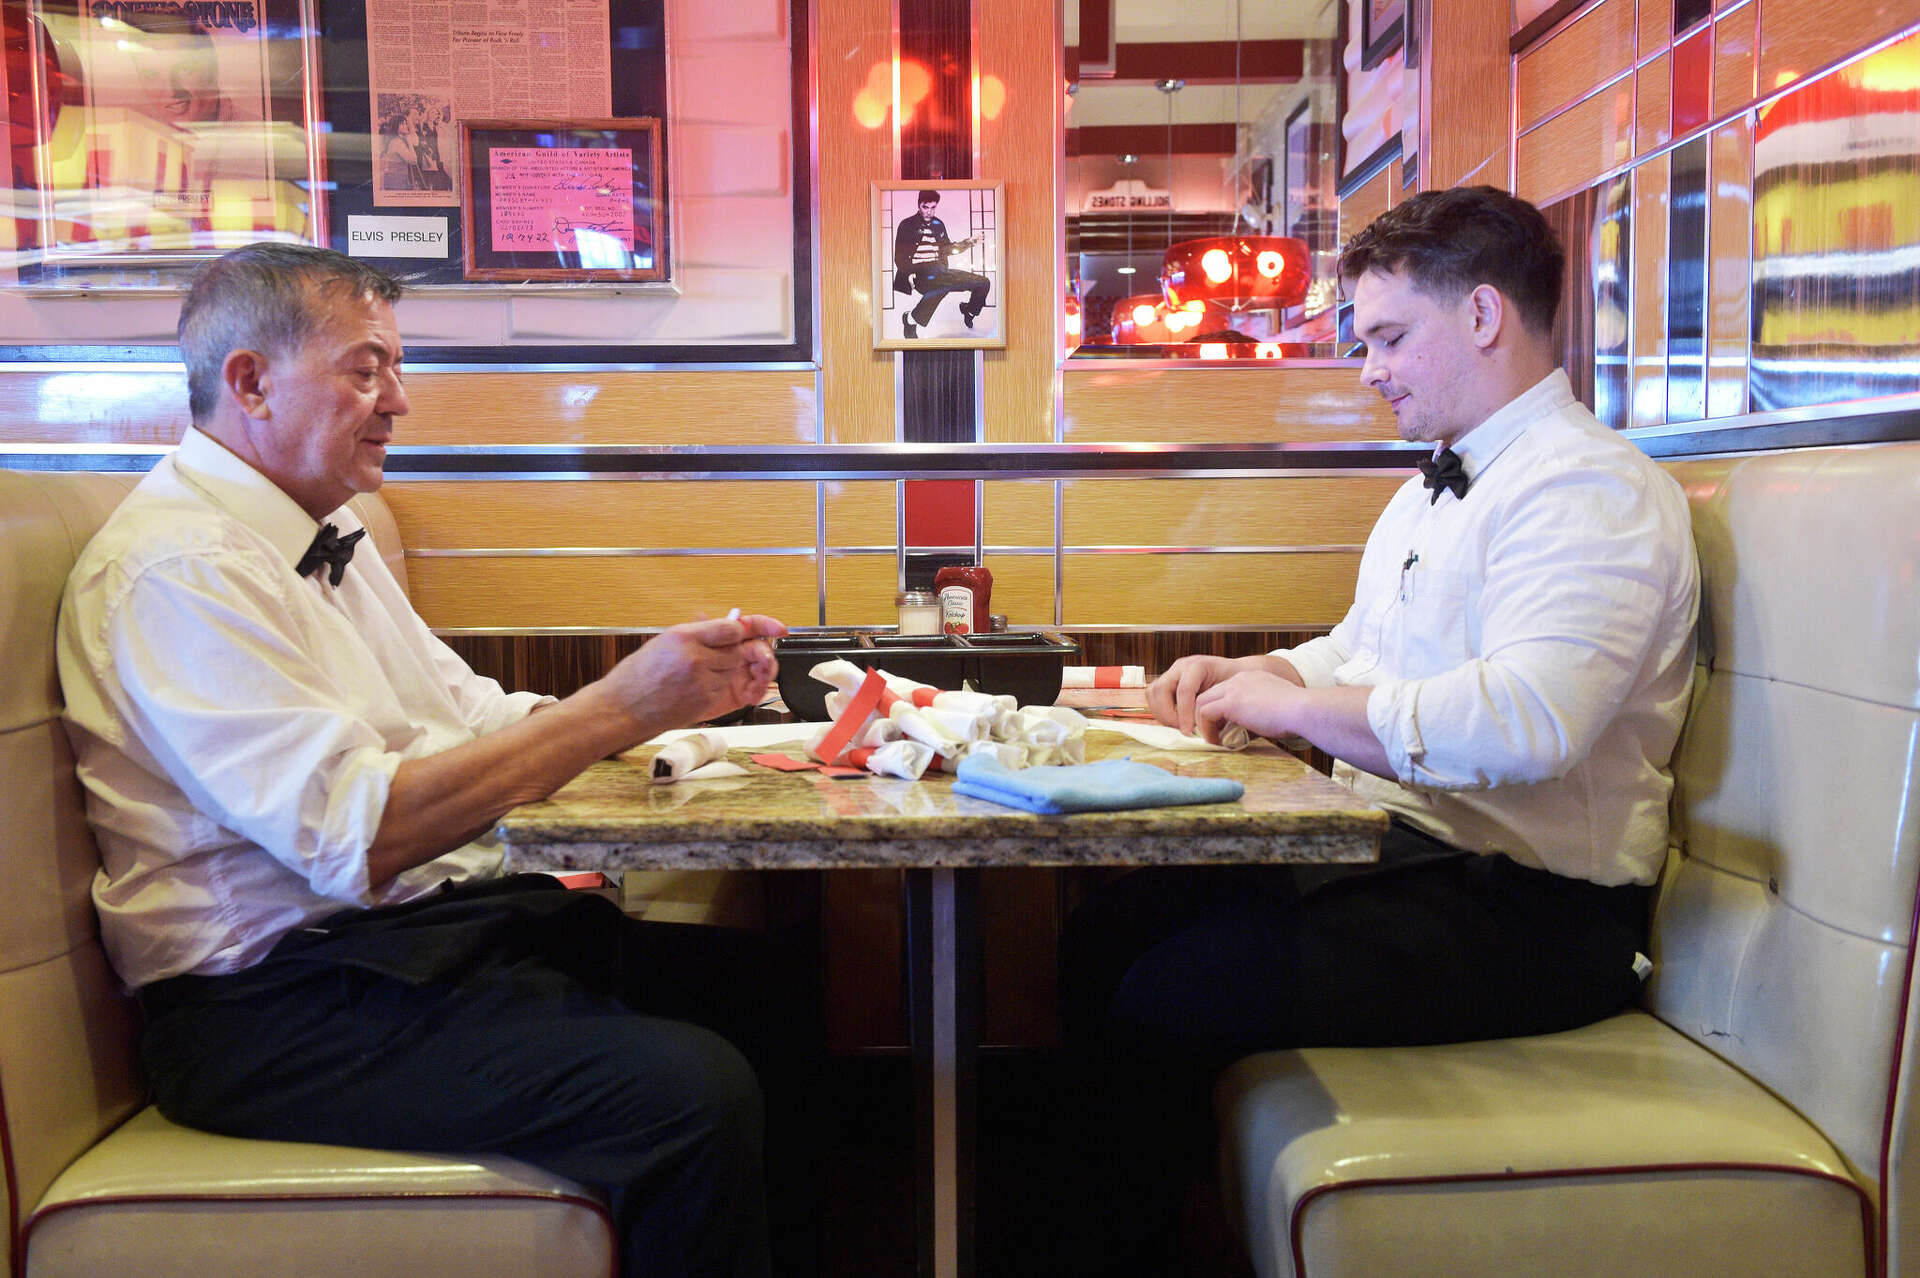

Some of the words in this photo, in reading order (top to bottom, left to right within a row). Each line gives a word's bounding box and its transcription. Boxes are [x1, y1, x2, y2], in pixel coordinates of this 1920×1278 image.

[573, 151, 600, 159] Variety
[352, 231, 384, 241] ELVIS
[391, 231, 443, 242] PRESLEY
[946, 609, 966, 619] Ketchup
